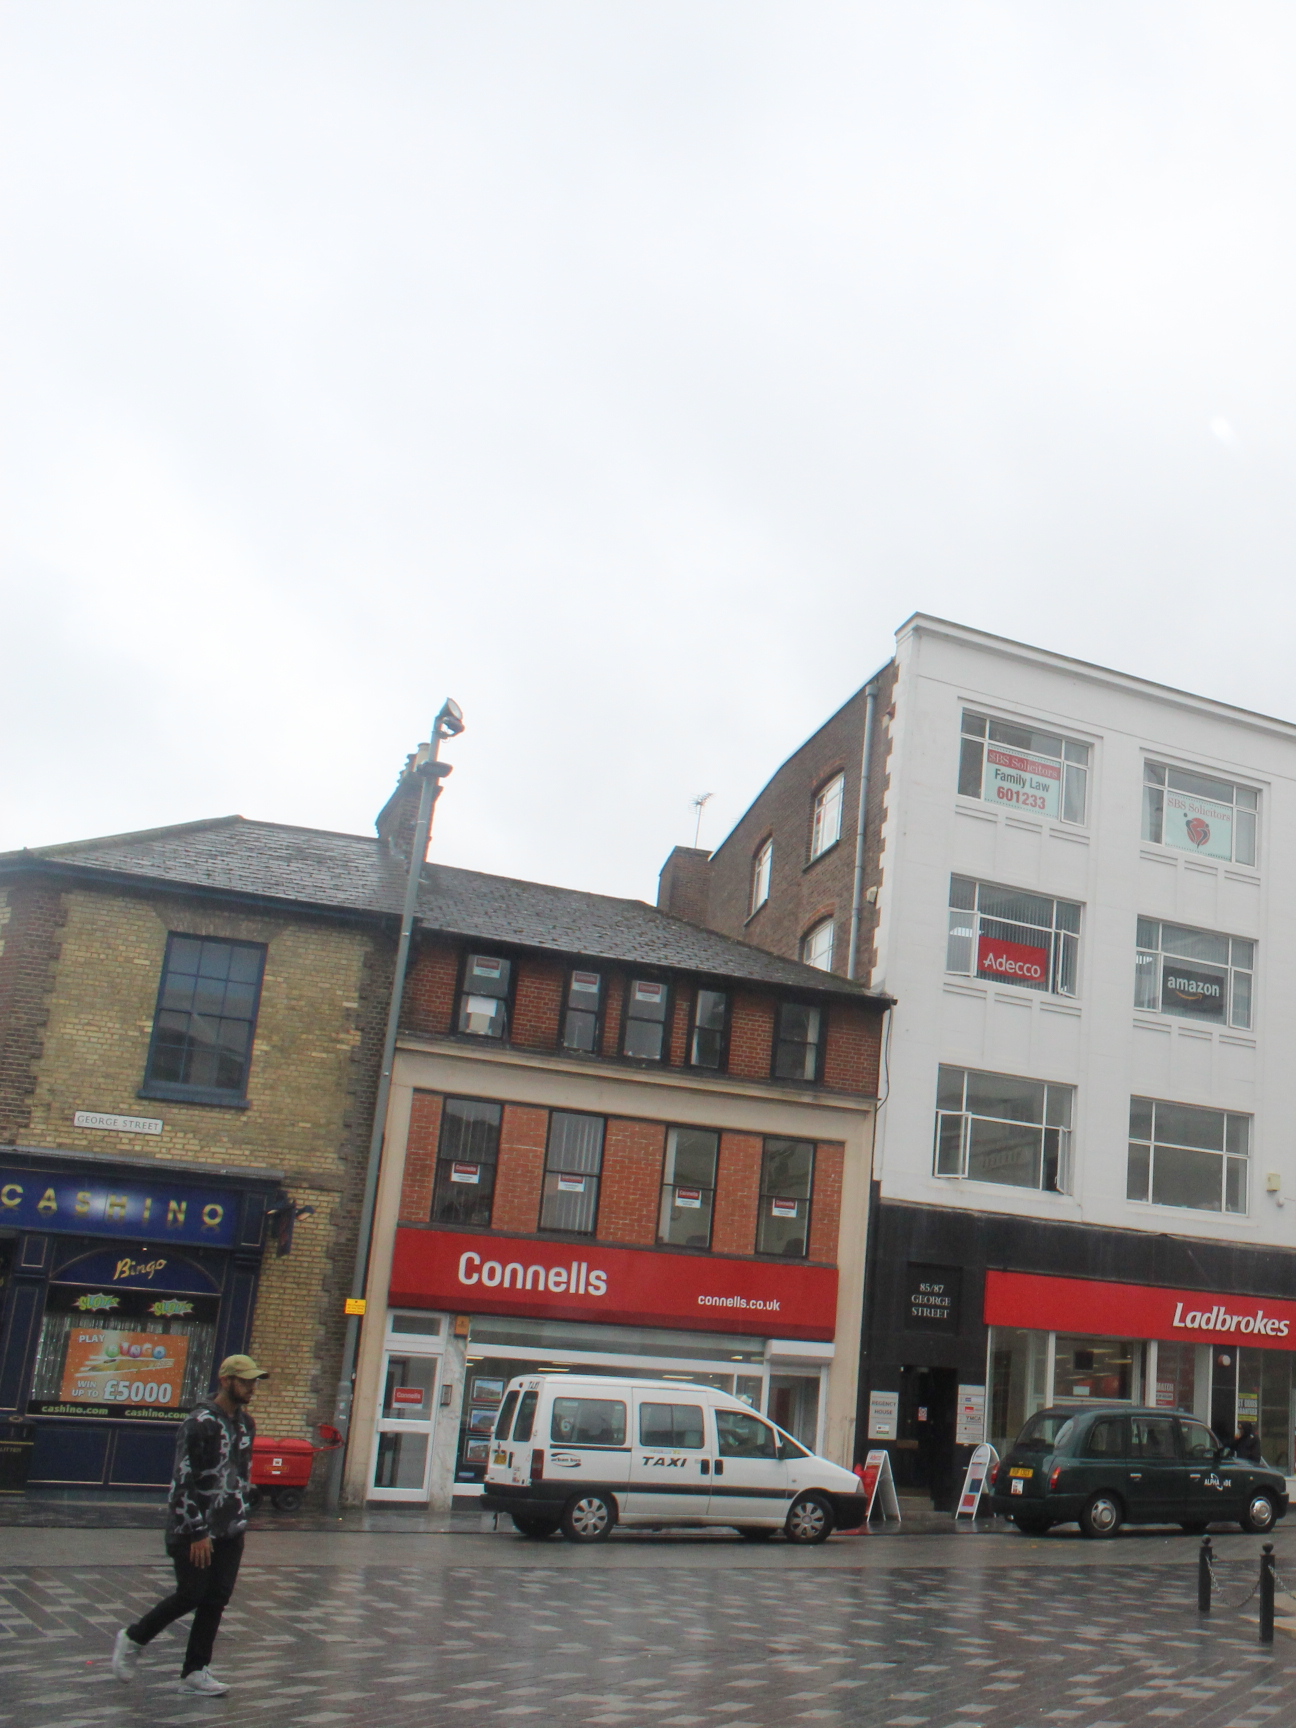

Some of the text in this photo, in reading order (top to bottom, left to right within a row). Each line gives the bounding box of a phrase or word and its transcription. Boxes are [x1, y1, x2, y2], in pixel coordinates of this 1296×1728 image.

[989, 751, 1058, 779] SBS Solicitors
[995, 768, 1050, 792] Family Law
[996, 785, 1046, 810] 601233
[1167, 796, 1232, 822] SBS Solicitors
[983, 952, 1041, 977] Adecco
[1167, 976, 1220, 997] amazon
[77, 1115, 159, 1131] GEORGE STREET
[1, 1183, 224, 1226] CASHINO
[113, 1258, 168, 1280] Bingo
[458, 1251, 608, 1296] Connells
[920, 1283, 945, 1293] 85/87
[698, 1295, 781, 1311] connells.co.uk
[911, 1294, 951, 1306] GEORGE
[912, 1307, 950, 1318] STREET
[1173, 1302, 1290, 1337] Ladbrokes
[78, 1334, 105, 1343] PLAY
[77, 1380, 97, 1388] WIN
[103, 1380, 172, 1403] £5000
[528, 1381, 539, 1389] TAXI
[71, 1389, 99, 1397] UP TO
[41, 1404, 109, 1415] cashino.com
[124, 1409, 189, 1419] cashino.com
[642, 1456, 688, 1468] TAXI
